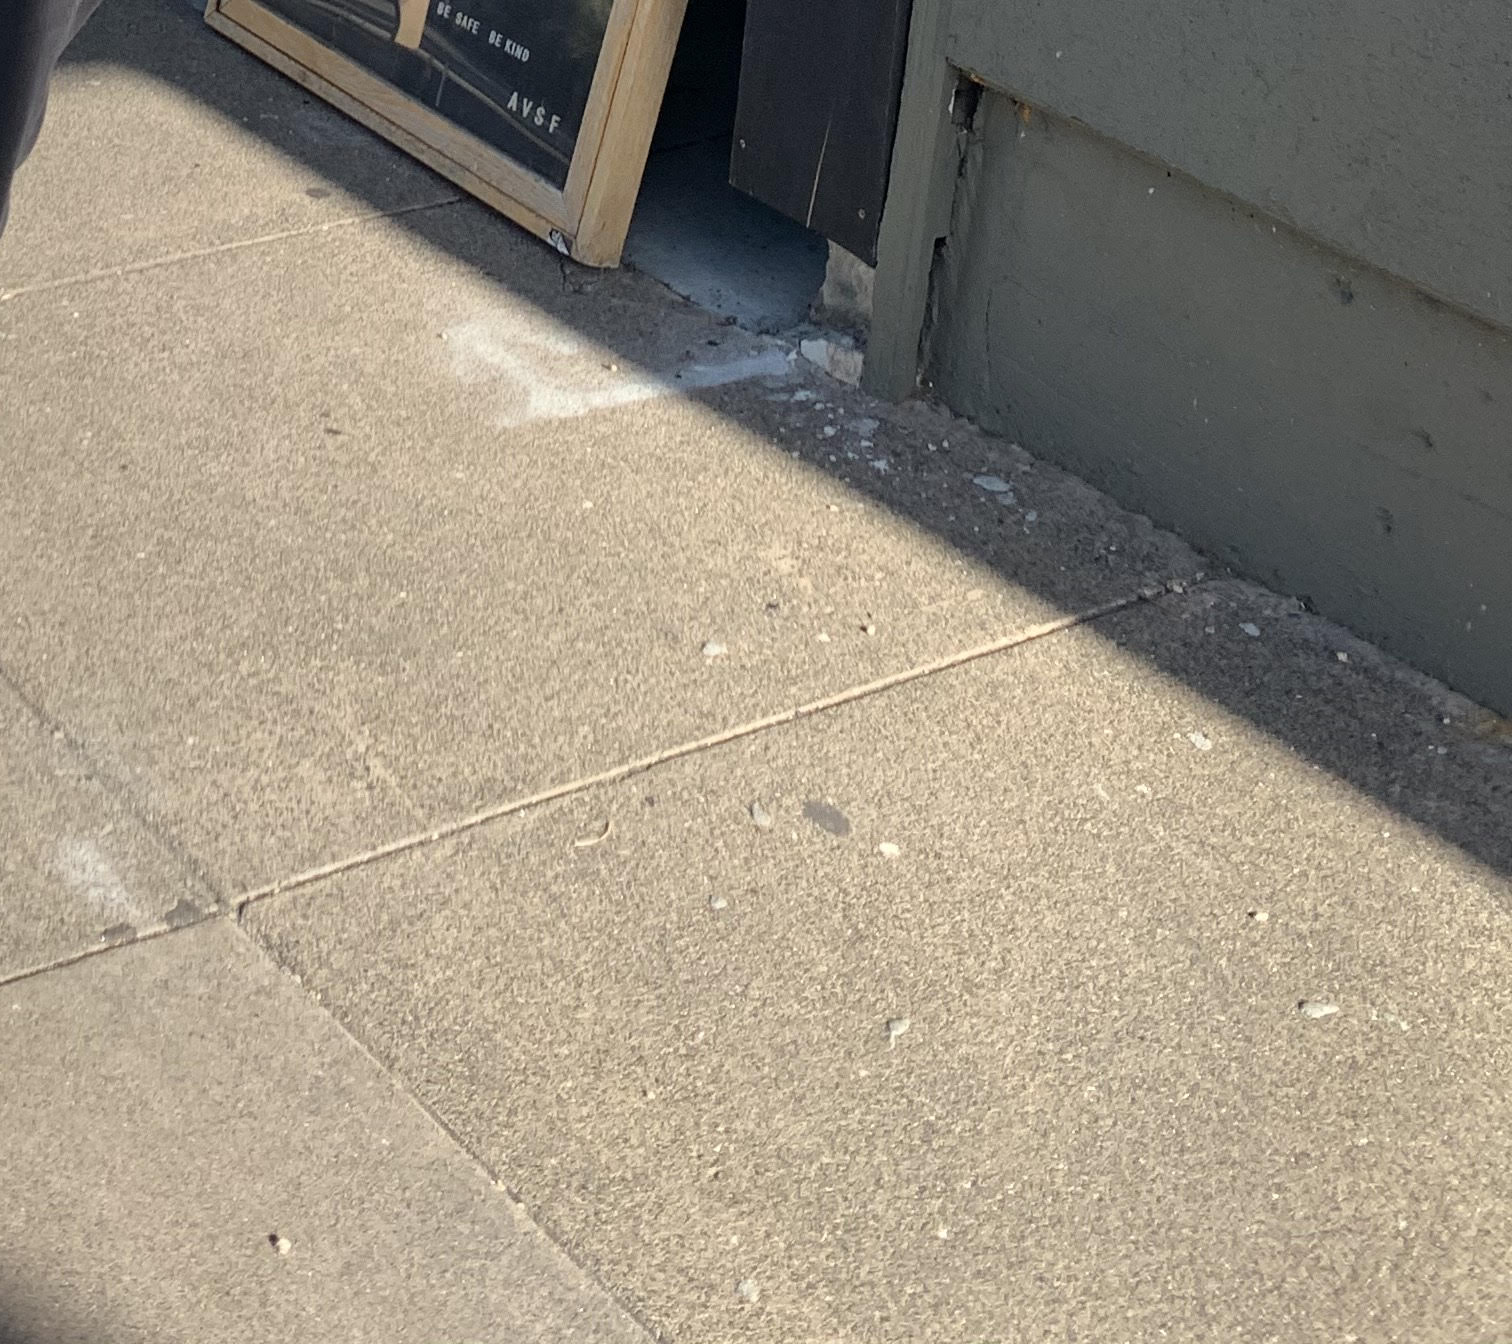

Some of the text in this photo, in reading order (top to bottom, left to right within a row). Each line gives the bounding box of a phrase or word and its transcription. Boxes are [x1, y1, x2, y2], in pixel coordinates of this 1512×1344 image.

[437, 1, 530, 63] BE SAFE BE KIND
[507, 91, 562, 134] AVSF
